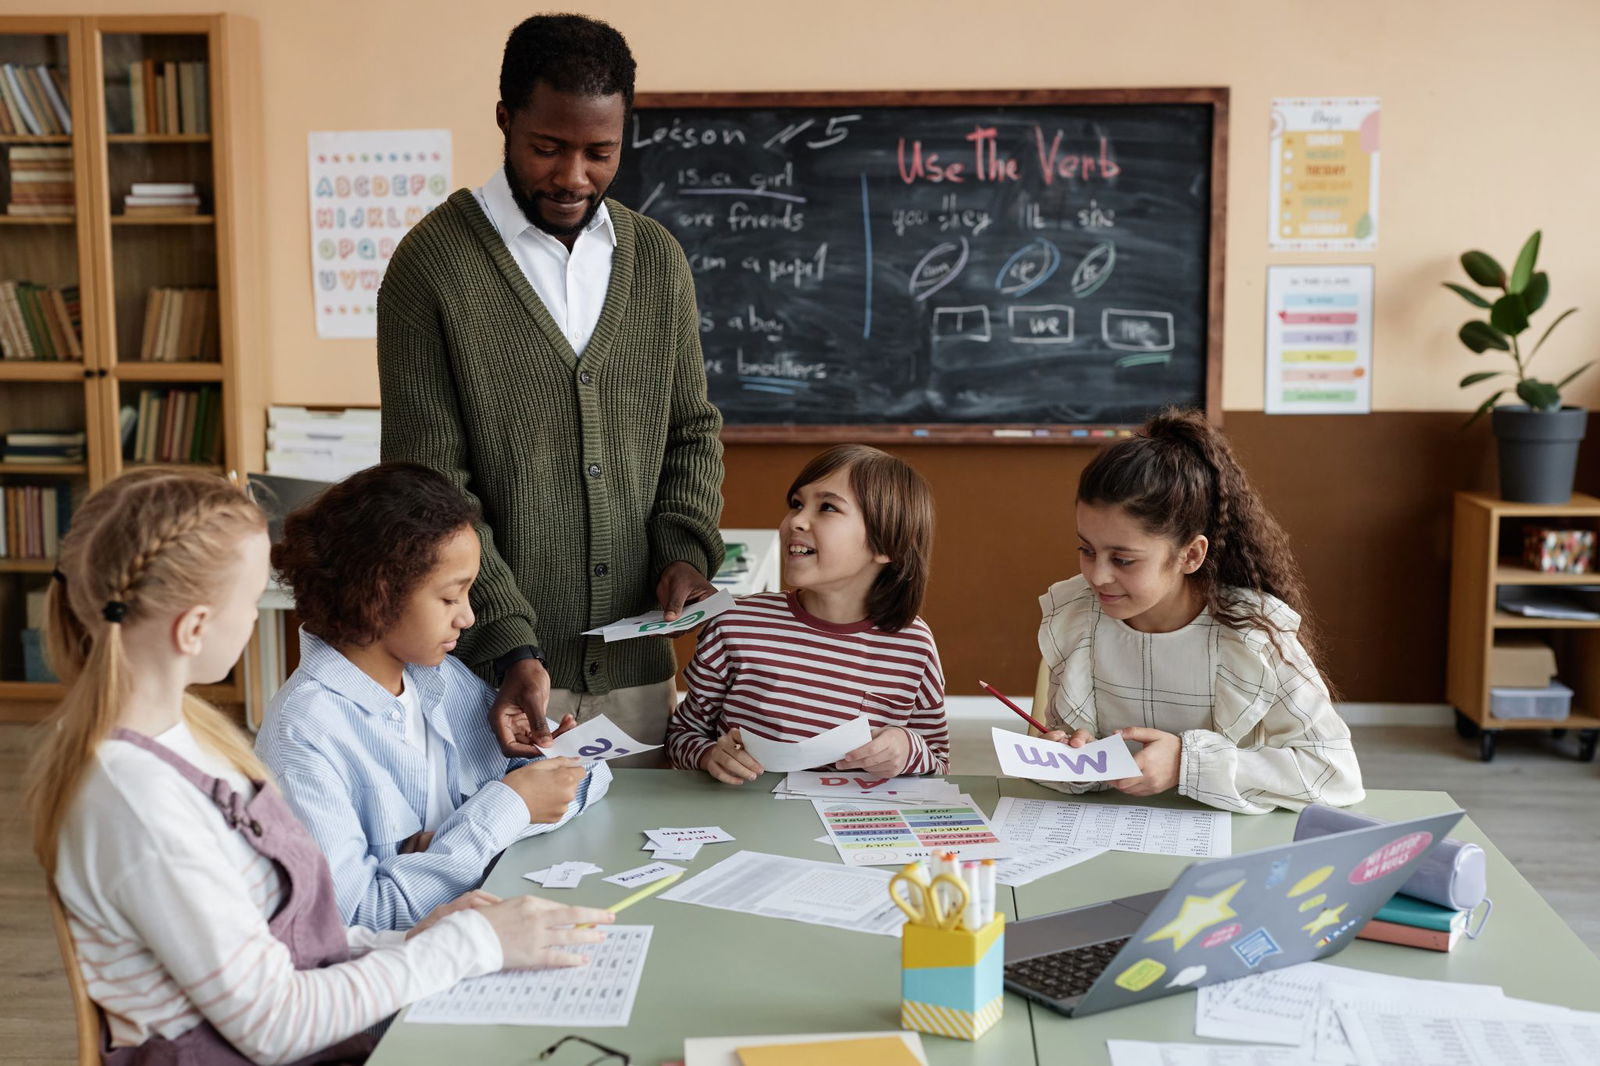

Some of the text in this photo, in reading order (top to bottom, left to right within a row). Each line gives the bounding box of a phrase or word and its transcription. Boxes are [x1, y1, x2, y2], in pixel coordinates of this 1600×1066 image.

[632, 114, 746, 148] Lesson
[807, 114, 862, 148] 5
[898, 124, 1122, 185] Use The Verb
[711, 172, 733, 185] a
[750, 161, 793, 194] girl
[678, 202, 804, 231] are friends
[893, 210, 928, 236] you
[741, 257, 760, 273] a
[728, 317, 744, 330] a
[1014, 744, 1107, 775] Mm
[819, 777, 890, 790] Aa
